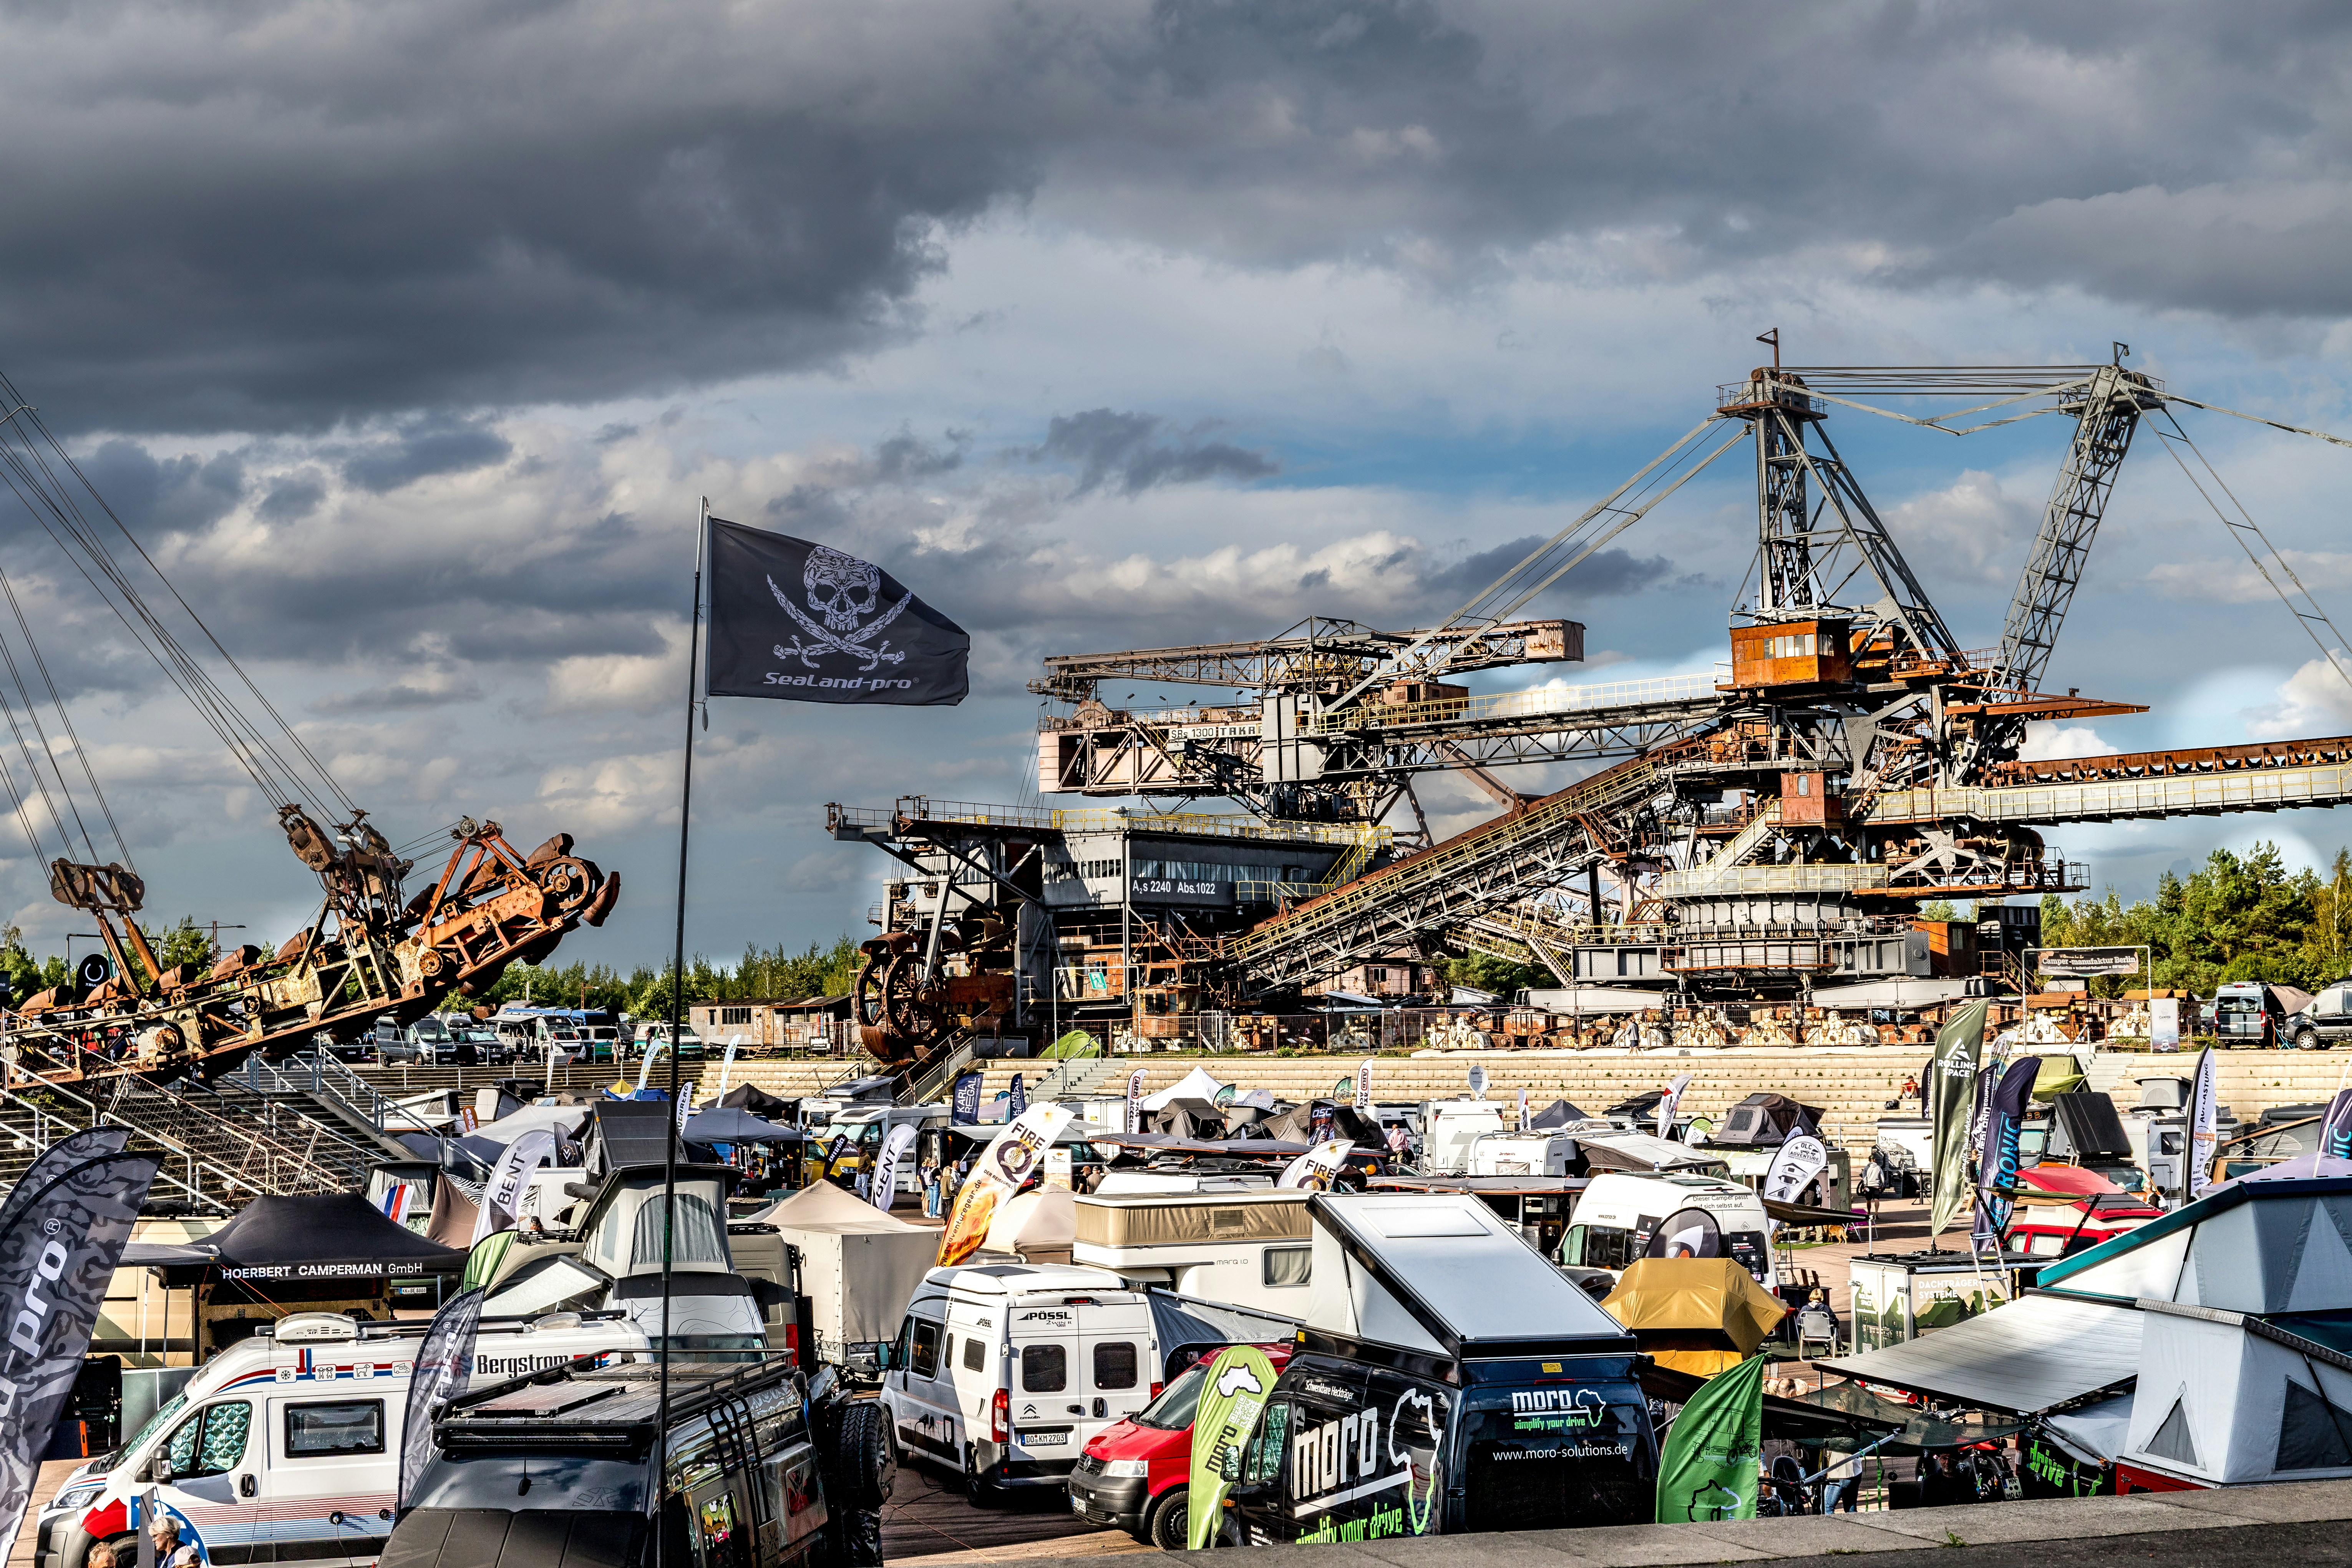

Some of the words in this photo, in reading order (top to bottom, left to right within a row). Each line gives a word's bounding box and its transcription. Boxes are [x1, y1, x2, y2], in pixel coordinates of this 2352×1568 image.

[1192, 728, 1213, 737] 1300
[1151, 881, 1171, 892] 2240
[1937, 1059, 1977, 1070] ROLLING
[1942, 1069, 1971, 1078] SPACE
[965, 1077, 976, 1113] REGAL
[1983, 1073, 1991, 1107] EQUIPMENT
[957, 1086, 967, 1113] KARL
[1963, 1103, 1972, 1136] Adventure
[1011, 1122, 1045, 1150] FIRE
[1790, 1151, 1819, 1161] ADVENTURE
[1305, 1159, 1336, 1179] FIRE
[984, 1169, 992, 1177] DER
[992, 1175, 1013, 1190] REISEGRILL
[1712, 1195, 1733, 1203] Camper
[223, 1266, 291, 1279] HOERBERT
[299, 1263, 381, 1276] CAMPERMAN
[388, 1263, 422, 1274] GmbH
[1918, 1289, 1958, 1299] SYSTEME
[979, 1317, 992, 1328] PÖSSL
[1029, 1311, 1072, 1320] PÖSSL
[1305, 1380, 1330, 1395] Schwenkbare
[1331, 1385, 1354, 1402] Heckträger
[1512, 1390, 1572, 1412] moro
[1514, 1417, 1545, 1431] simplify
[1546, 1419, 1564, 1430] your
[1566, 1416, 1586, 1427] drive
[1026, 1435, 1034, 1443] DO
[1049, 1434, 1064, 1442] 2703
[1205, 1424, 1237, 1473] moro
[1294, 1407, 1378, 1499] moro
[1493, 1443, 1627, 1460] www.moro-solutions.de
[2030, 1440, 2065, 1487] drive
[1295, 1515, 1336, 1544] simplify
[1340, 1518, 1367, 1542] your
[1370, 1502, 1402, 1540] drive
